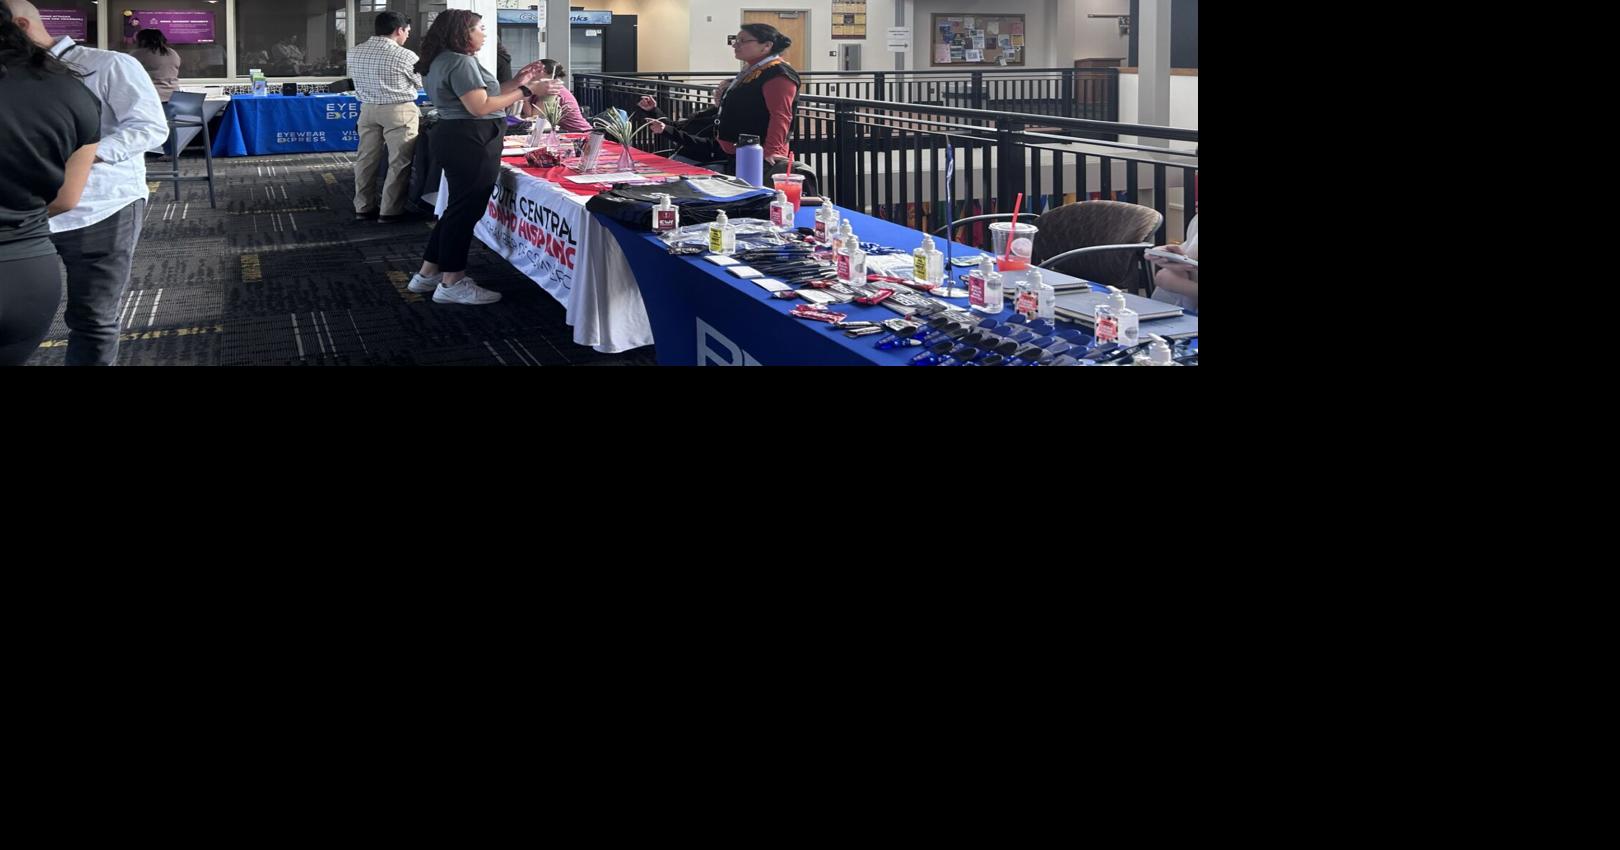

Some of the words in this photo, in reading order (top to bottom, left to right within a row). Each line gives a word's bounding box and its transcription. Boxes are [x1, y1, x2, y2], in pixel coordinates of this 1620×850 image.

[488, 200, 517, 233] IDAHO
[518, 217, 577, 271] HISPANC
[491, 183, 517, 213] OUTH
[519, 196, 577, 246] CENTRAL
